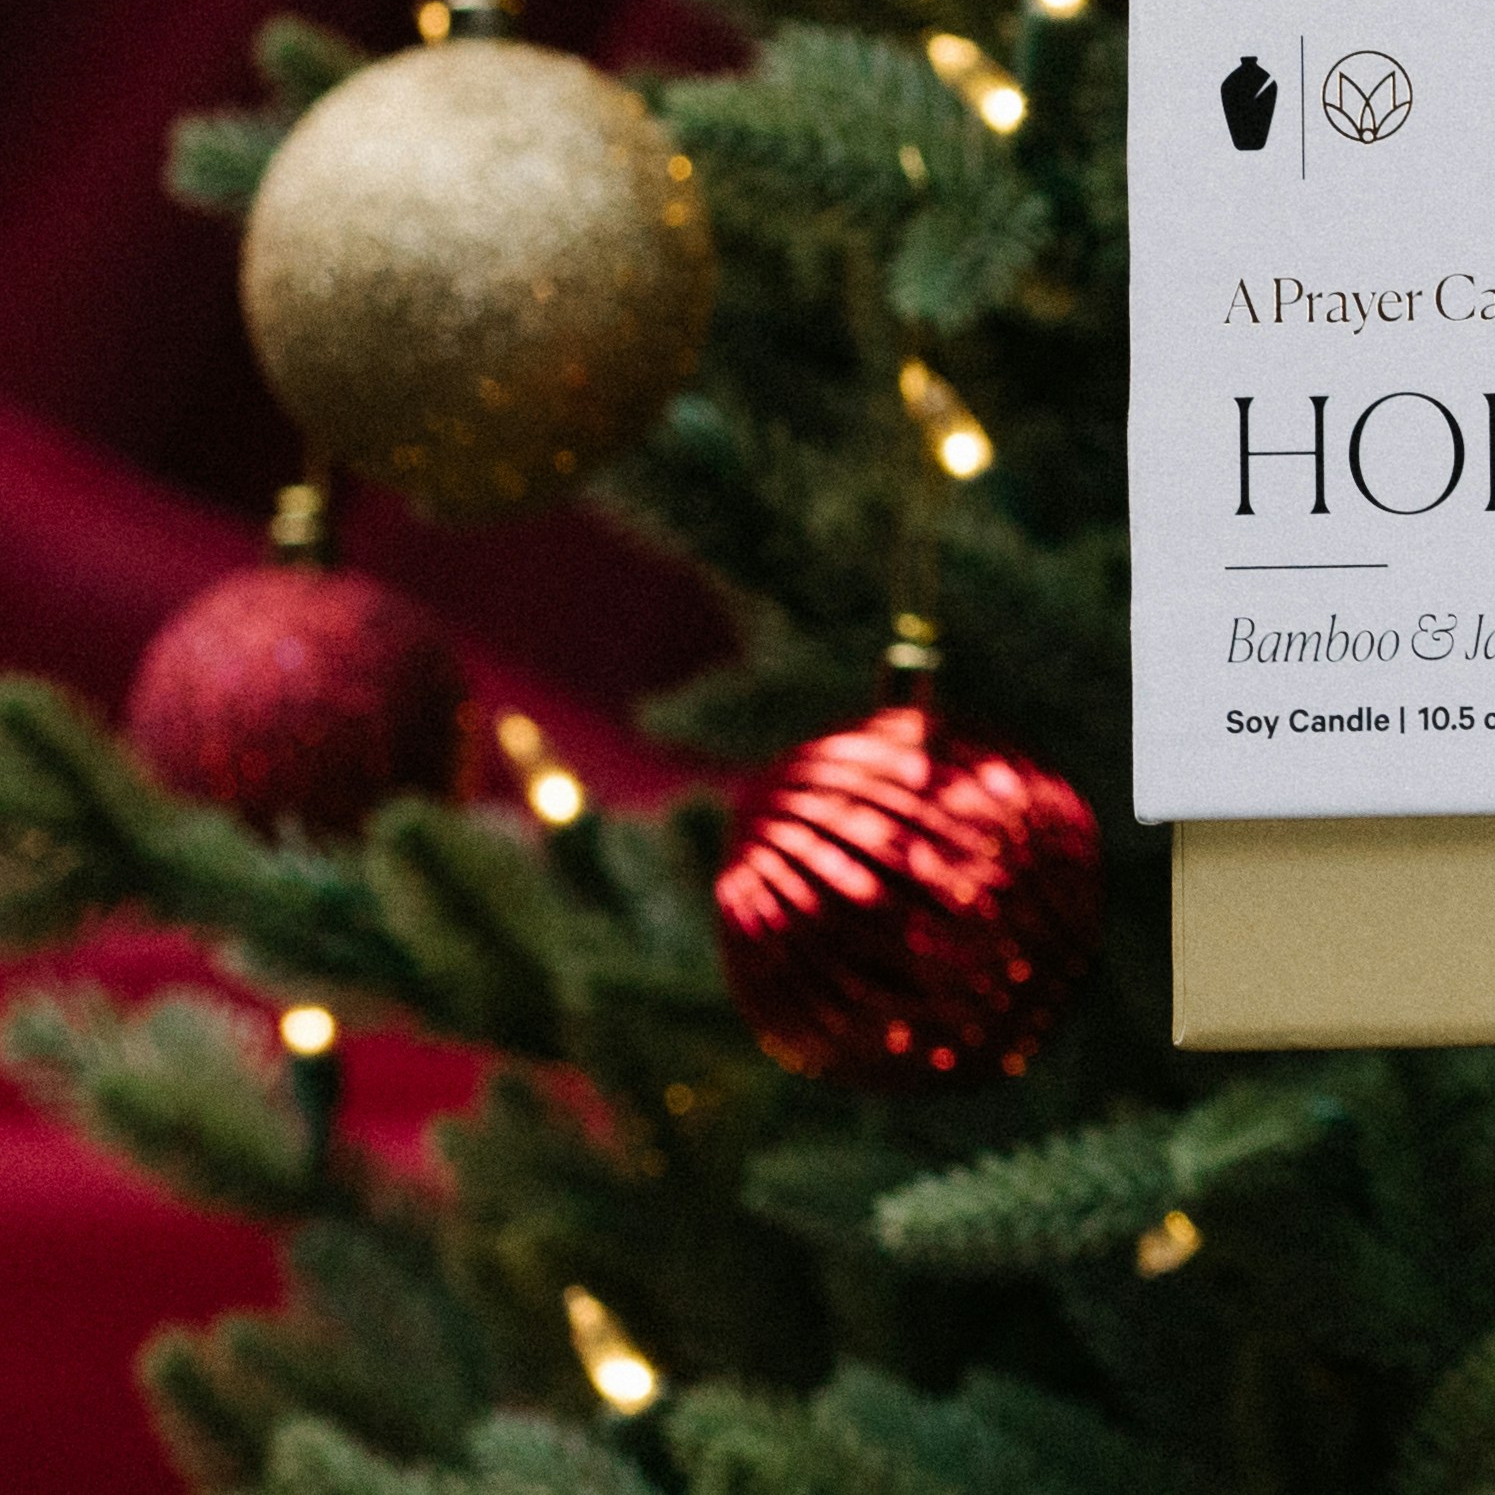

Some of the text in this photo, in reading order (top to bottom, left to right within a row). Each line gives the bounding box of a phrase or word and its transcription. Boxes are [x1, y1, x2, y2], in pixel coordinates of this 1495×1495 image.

[1222, 276, 1262, 326] A
[1271, 275, 1425, 337] Prayer
[1225, 611, 1402, 665] Bamboo
[1409, 611, 1459, 663] &
[1224, 707, 1282, 741] Soy
[1287, 704, 1392, 735] Candle
[1416, 704, 1477, 733] 10.5
